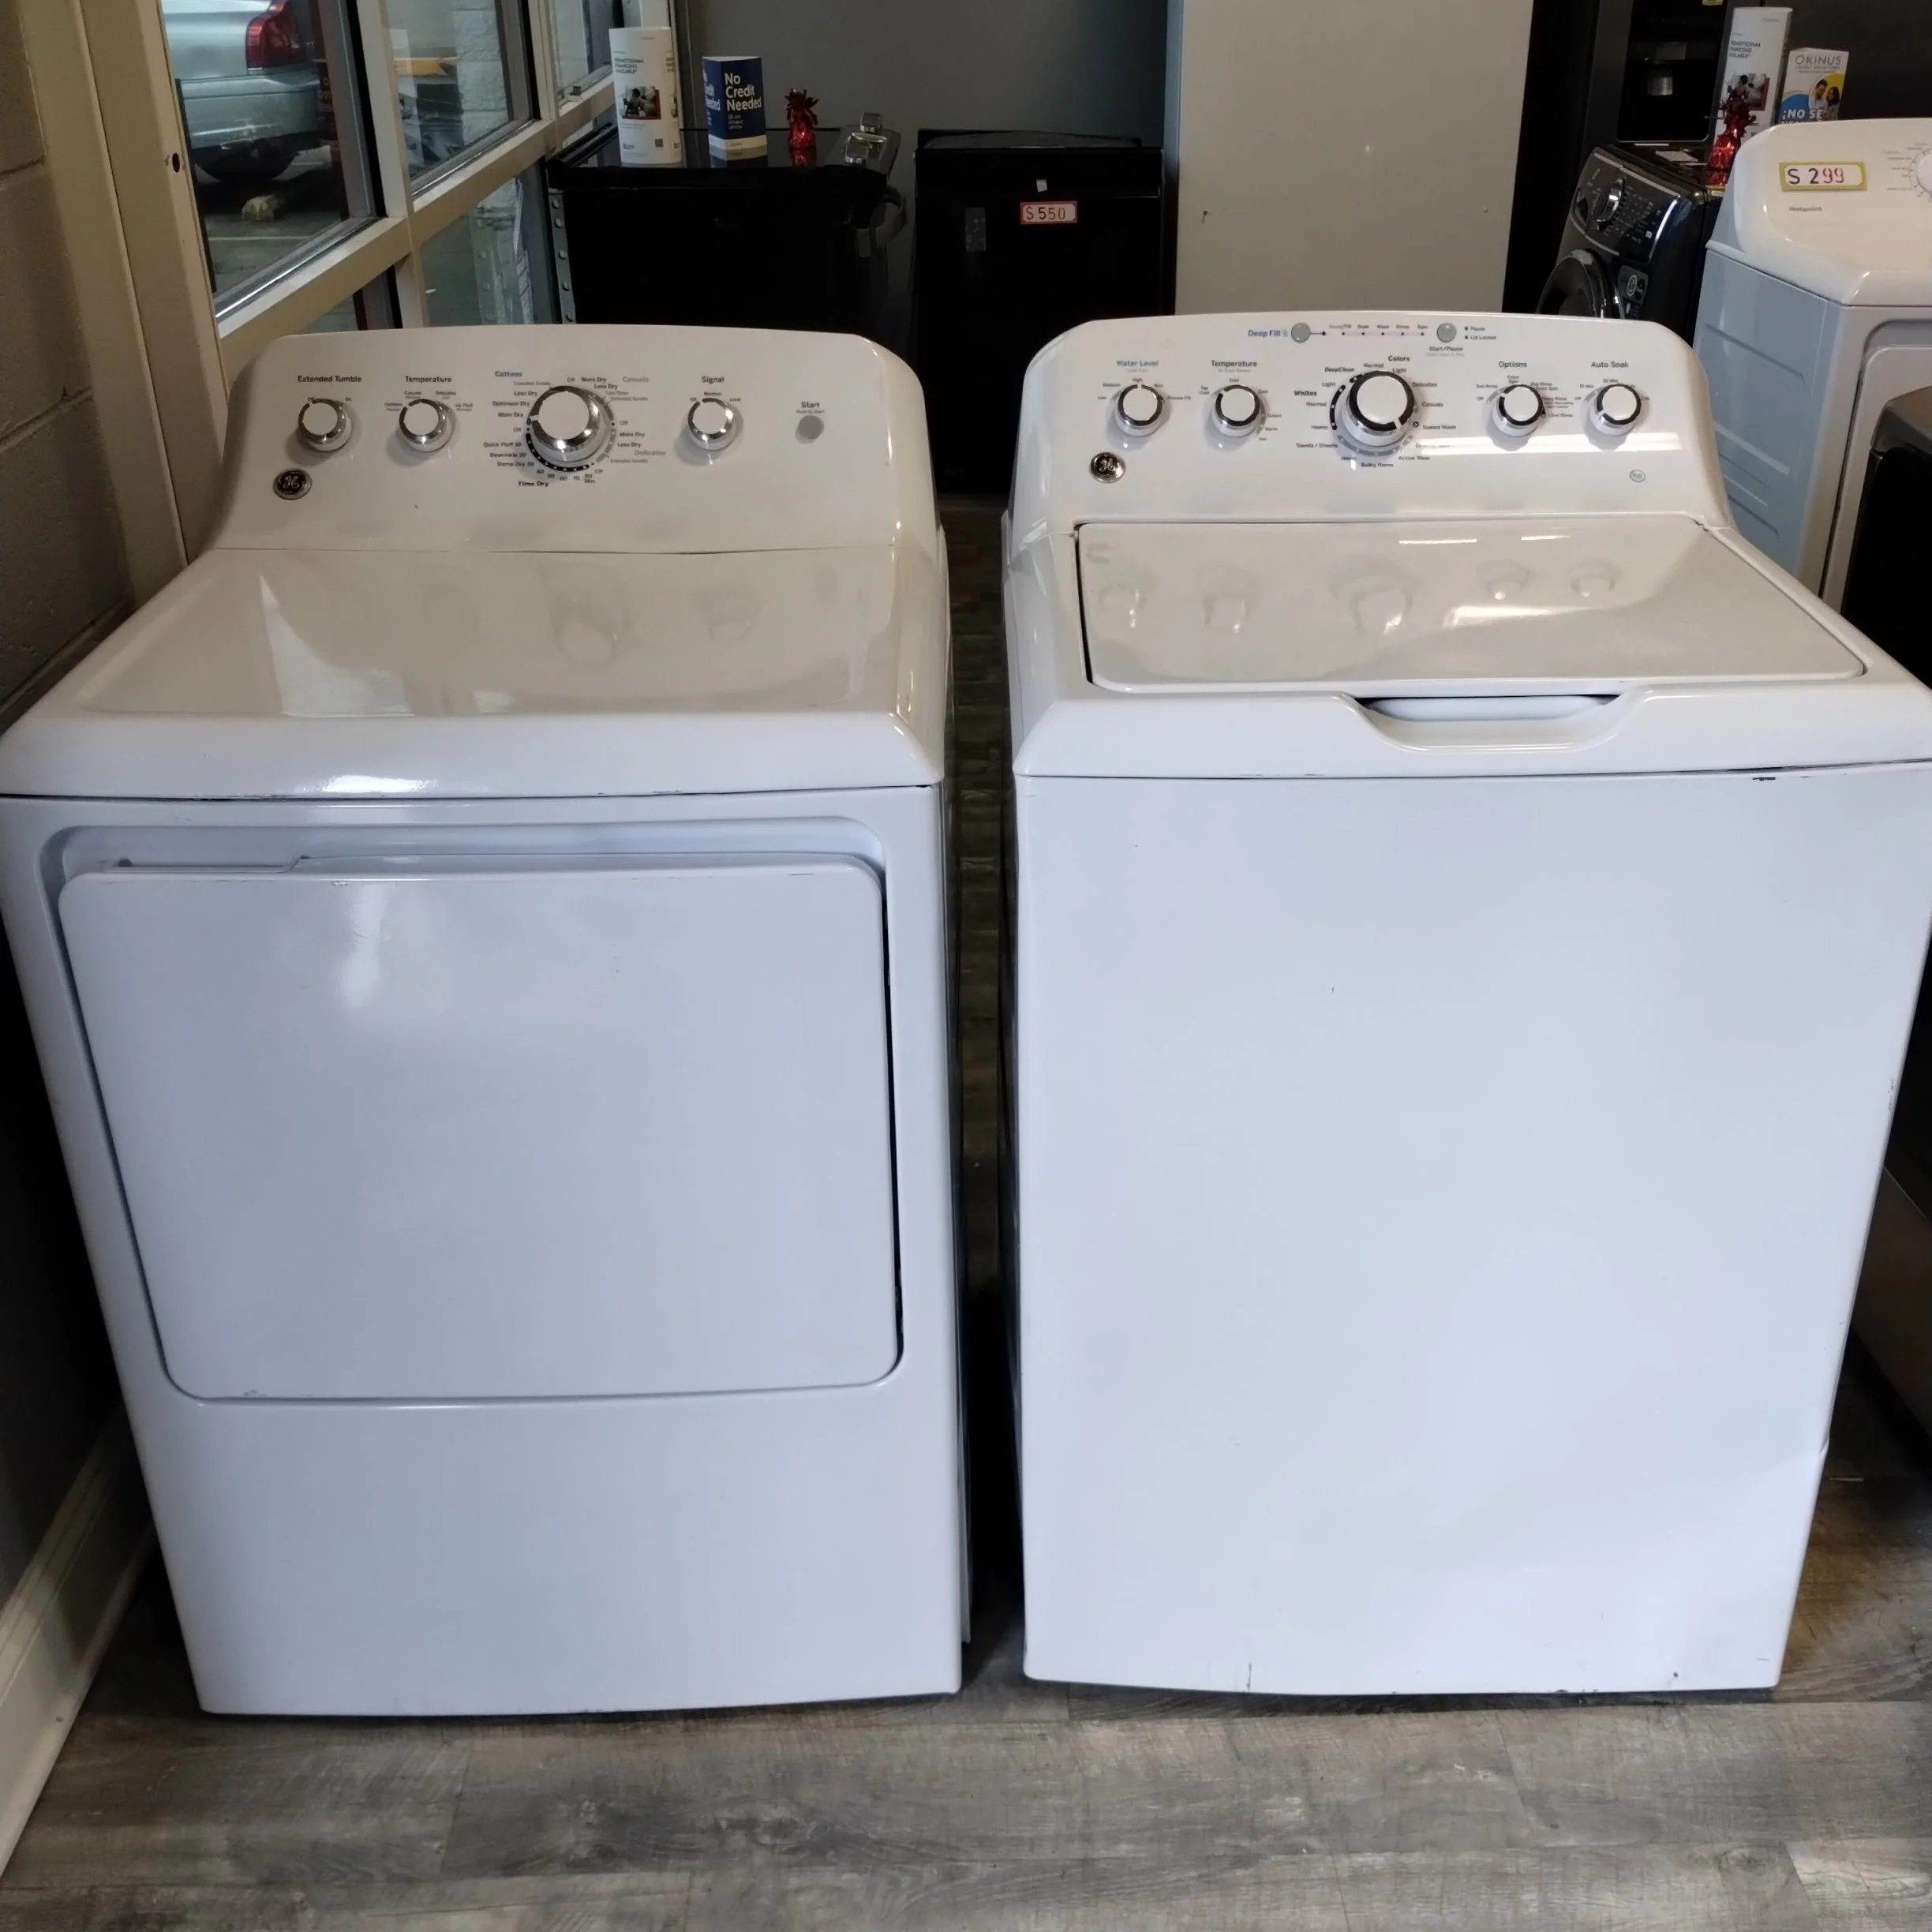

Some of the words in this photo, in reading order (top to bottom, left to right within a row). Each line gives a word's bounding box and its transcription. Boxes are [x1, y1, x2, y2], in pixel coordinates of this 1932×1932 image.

[1795, 55, 1841, 66] OKINUS
[724, 73, 741, 85] No
[726, 84, 755, 98] Credit
[727, 95, 762, 111] Needed
[1809, 108, 1825, 119] SE
[1211, 360, 1258, 369] Temperature
[1499, 361, 1528, 369] Options
[406, 376, 452, 384] Temperature
[702, 376, 725, 384] Signal
[537, 481, 550, 489] Dry
